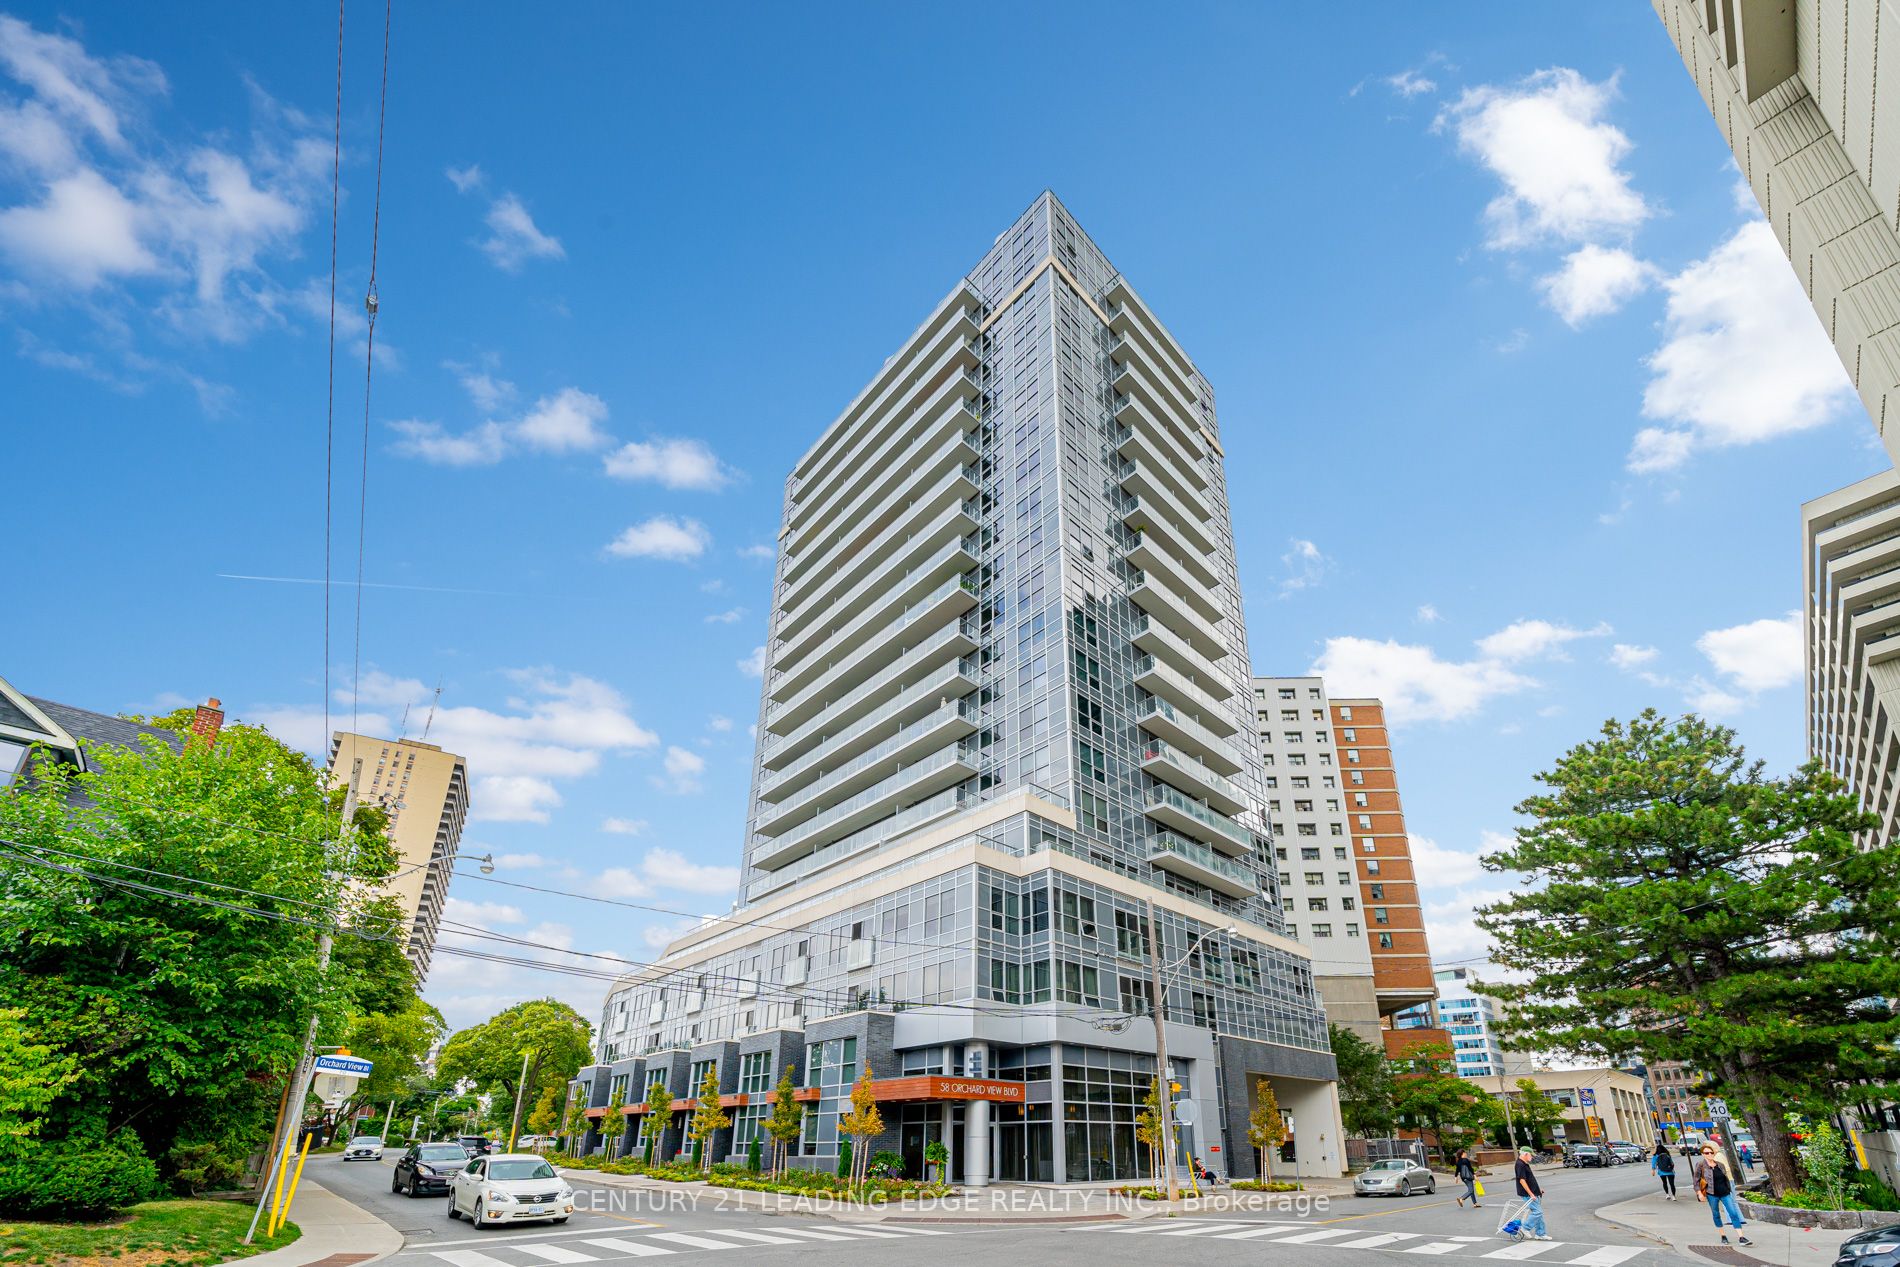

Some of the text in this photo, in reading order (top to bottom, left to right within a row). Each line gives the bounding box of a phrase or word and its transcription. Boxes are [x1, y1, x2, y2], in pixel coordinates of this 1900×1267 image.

[320, 1059, 347, 1068] Orchard
[348, 1062, 363, 1070] View
[940, 1082, 1018, 1096] 58 ORCHARD VIEW BLVD
[1710, 1105, 1726, 1115] 40
